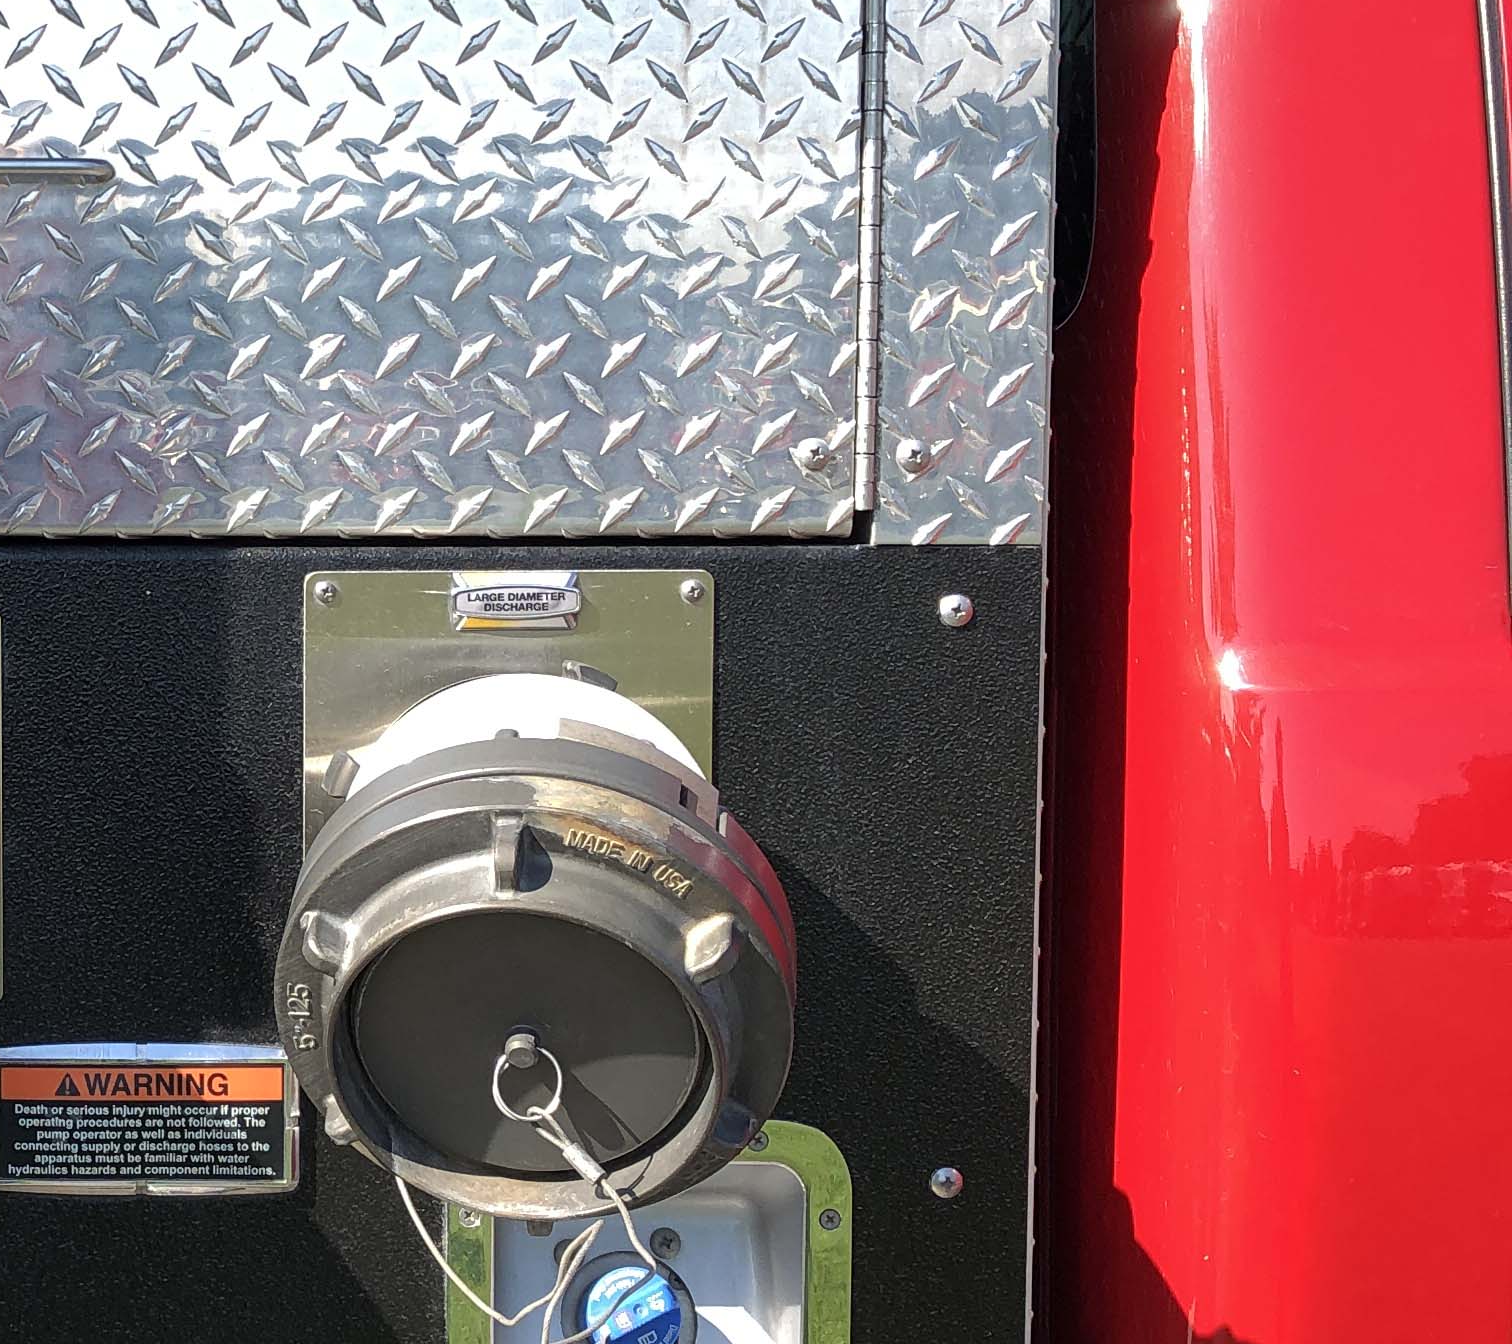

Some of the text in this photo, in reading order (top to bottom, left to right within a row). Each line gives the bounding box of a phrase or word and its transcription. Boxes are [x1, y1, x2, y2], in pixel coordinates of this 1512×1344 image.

[467, 592, 567, 602] LARGE DIAMETER
[483, 602, 550, 612] DISCHARGE
[563, 828, 694, 900] MADE IN USA
[83, 1072, 229, 1097] WARNING
[14, 1103, 270, 1117] Death or serious injury might occur if proper
[18, 1117, 266, 1129] operating procedures are not followed. The
[36, 1129, 248, 1141] pump operator as well as individuals
[14, 1141, 270, 1153] connecting supply or discharge hoses to the
[34, 1153, 250, 1165] apparatus must be familiar with water
[8, 1164, 277, 1176] hydraulics hazards and component limitations.
